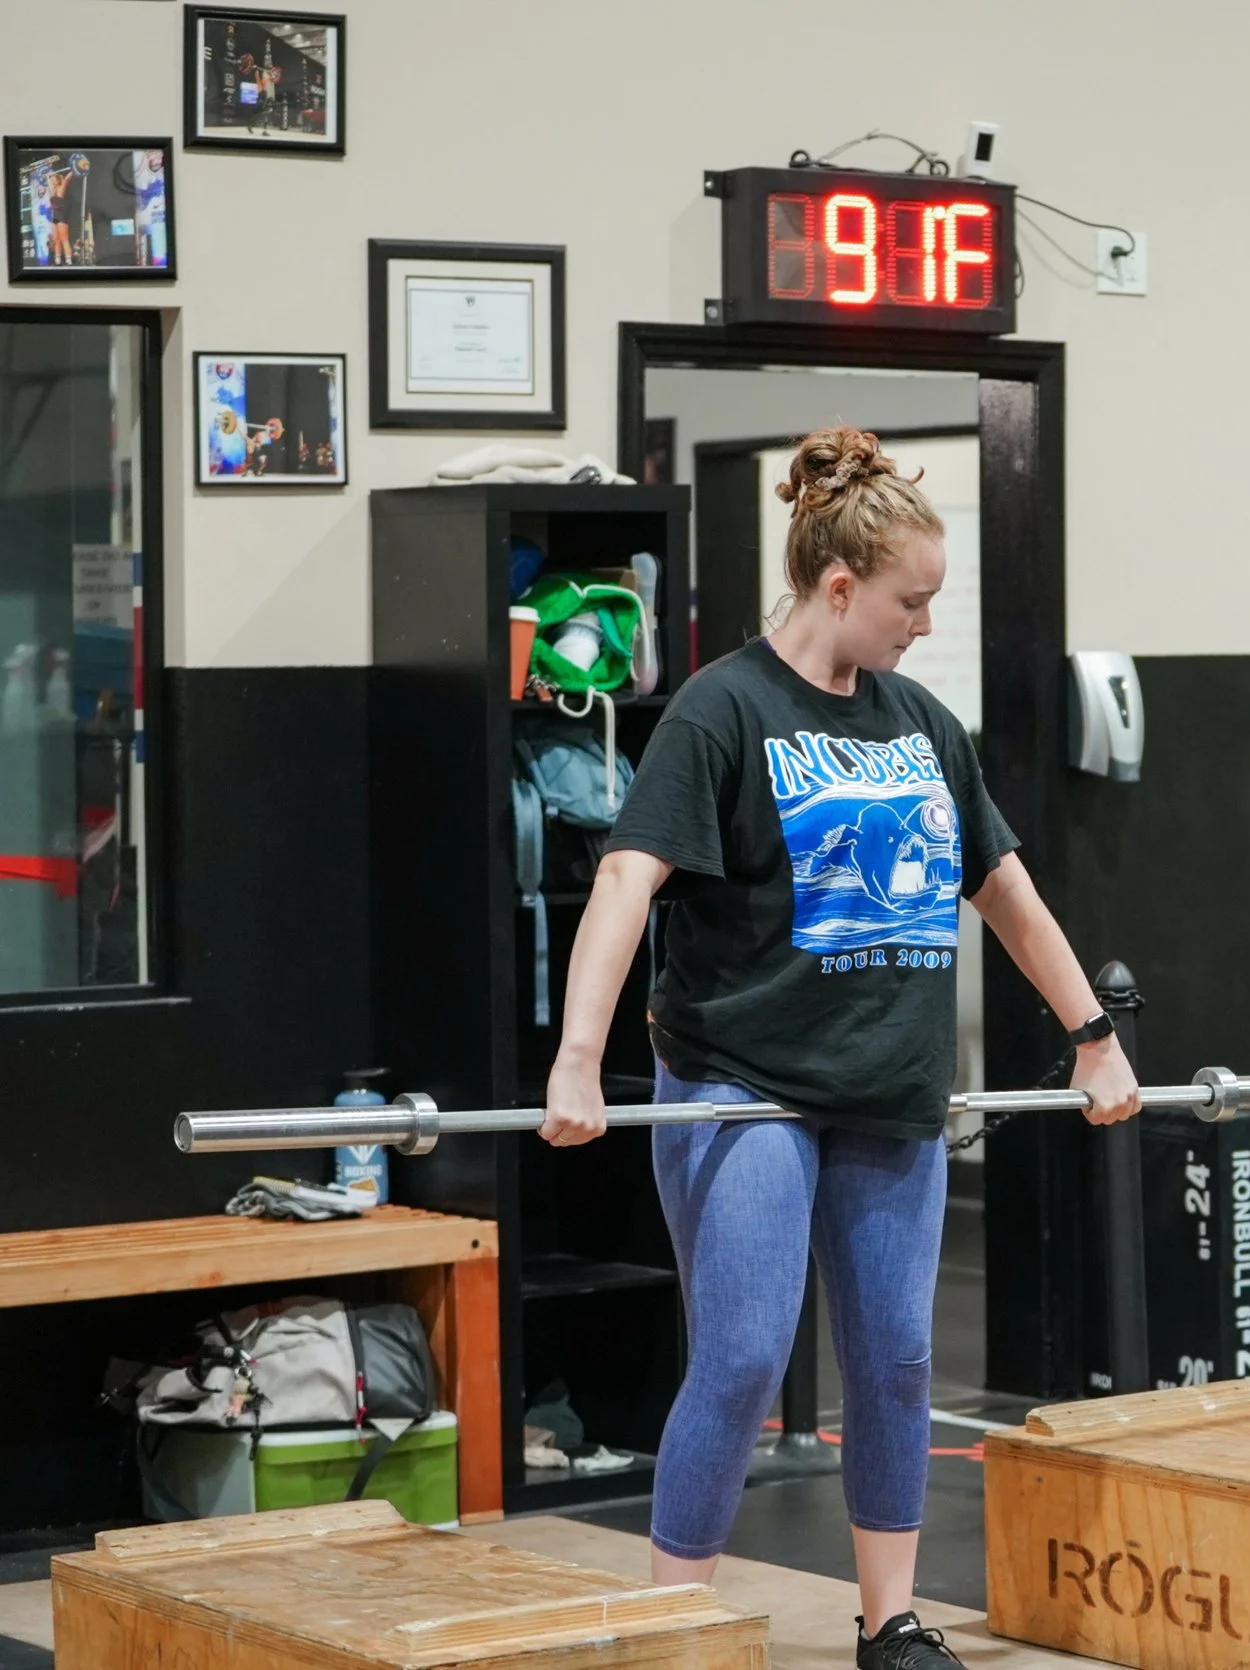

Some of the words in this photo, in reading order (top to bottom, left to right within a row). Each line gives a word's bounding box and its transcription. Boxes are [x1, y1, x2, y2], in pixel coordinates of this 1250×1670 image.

[764, 731, 946, 799] INCUBUS
[821, 949, 887, 974] TOUR
[896, 949, 952, 969] 2009
